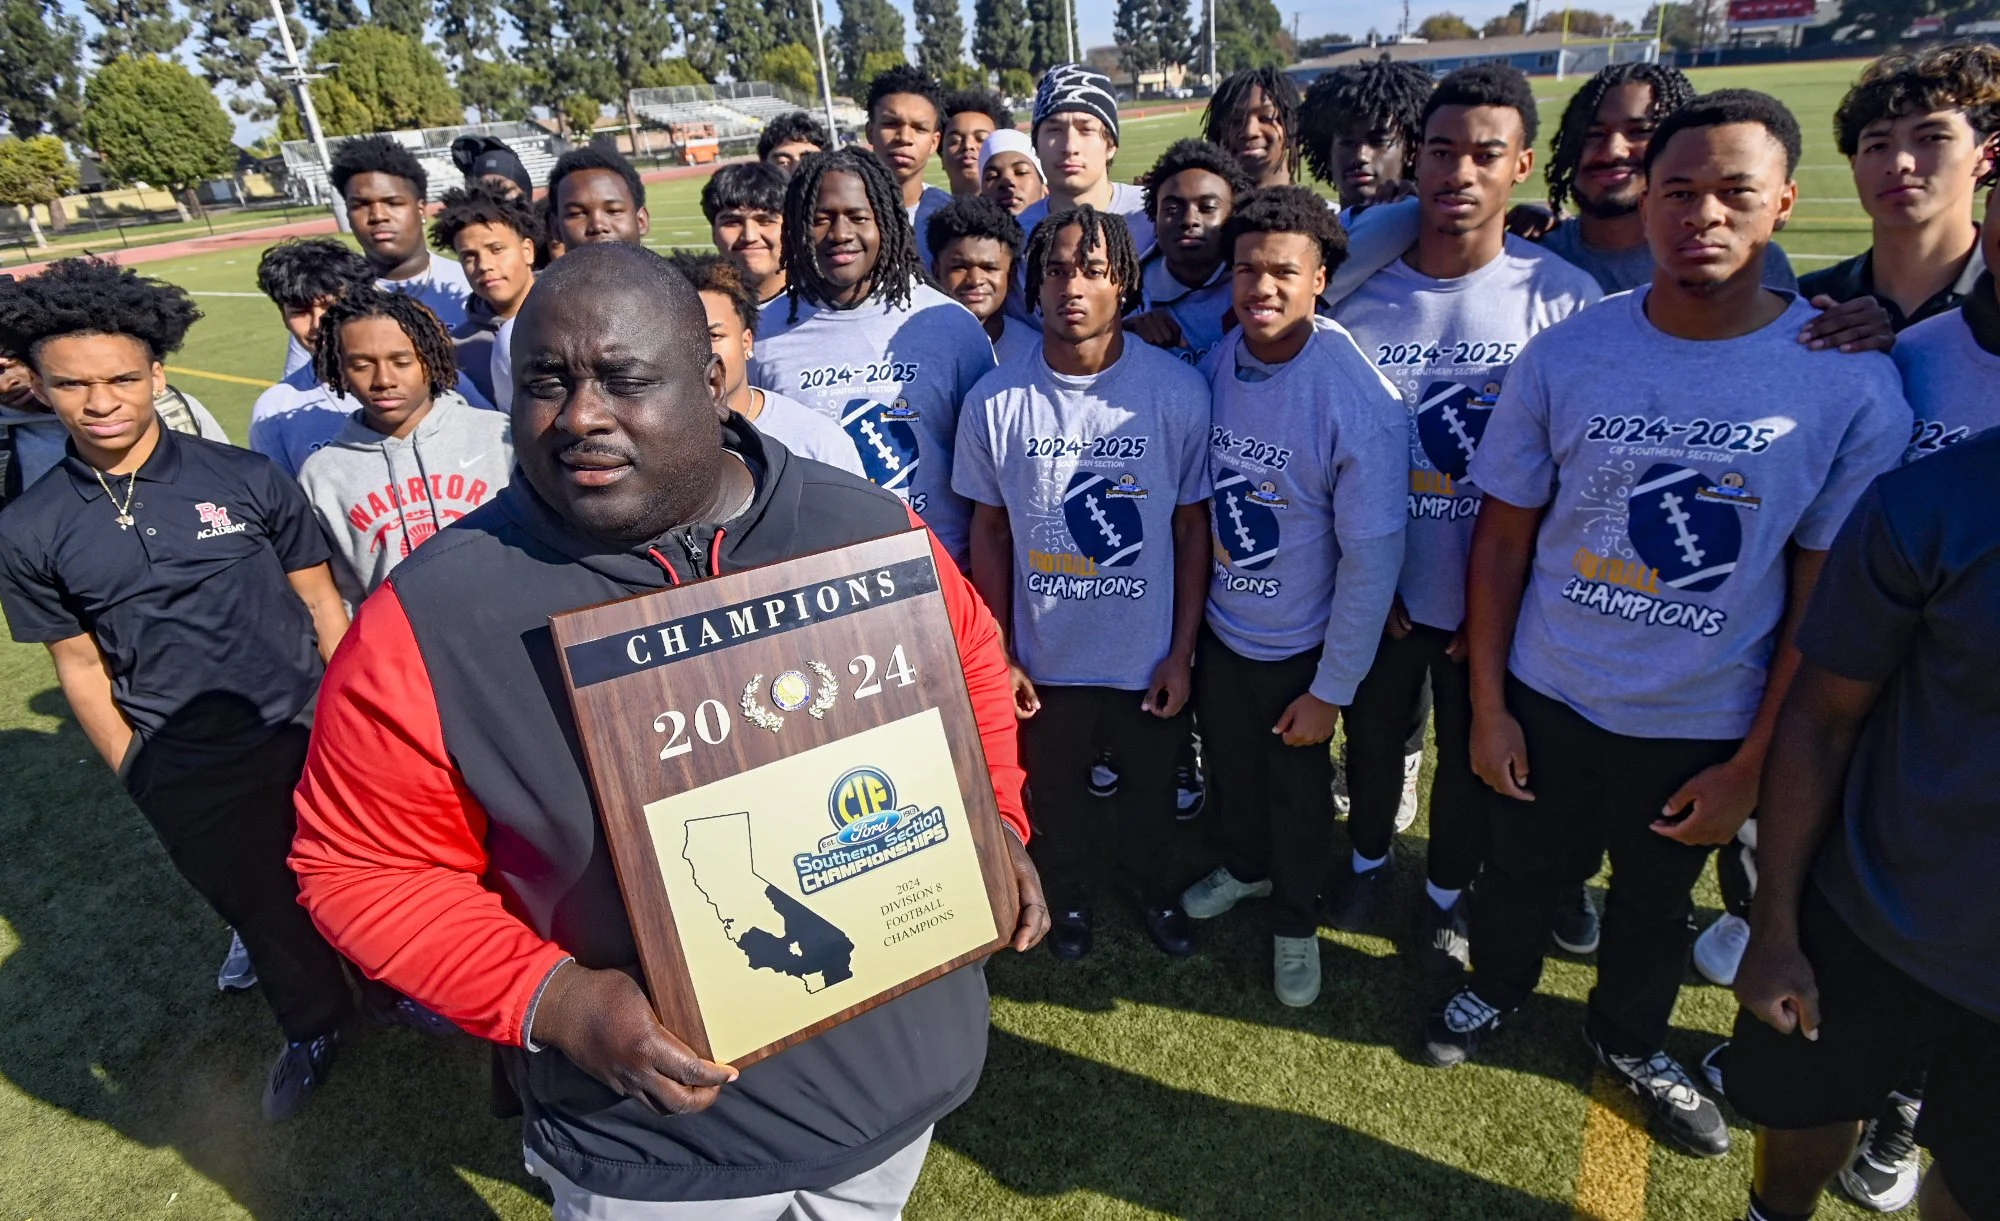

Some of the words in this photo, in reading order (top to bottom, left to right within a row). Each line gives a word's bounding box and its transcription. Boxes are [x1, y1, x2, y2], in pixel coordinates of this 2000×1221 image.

[1378, 340, 1517, 367] 2024-2025
[801, 362, 920, 391] 2024-2025
[1411, 367, 1453, 377] SOUTHERN
[868, 385, 899, 394] SECTION
[1026, 436, 1149, 460] 2024-2025
[1209, 423, 1292, 471] 024-2025
[1587, 414, 1774, 454] 2024-2025
[1057, 460, 1092, 468] SOUTHERN
[1094, 460, 1125, 468] SECTION
[1609, 446, 1626, 455] CIF
[1628, 446, 1684, 458] SOUTHERN
[1686, 448, 1735, 464] SECTION
[195, 502, 231, 528] PM
[1408, 494, 1481, 520] AMPIO
[197, 523, 246, 540] ACADEMY
[1029, 549, 1099, 577] FOOTBALL
[1028, 573, 1147, 600] CHAMPIONS
[1213, 558, 1280, 598] MPIONS
[627, 570, 896, 665] CHAMPIONS
[1561, 574, 1727, 636] CHAMPIONS
[653, 699, 731, 761] 20
[847, 644, 917, 700] 24
[838, 775, 888, 824] CIF
[796, 843, 878, 875] Southern
[884, 808, 942, 848] Section
[850, 816, 890, 842] Ford
[801, 823, 947, 893] CHAMPIONSHIPS
[880, 887, 934, 916] DIVISION
[936, 883, 943, 892] 8
[896, 878, 921, 895] 2024
[883, 909, 955, 947] CHAMPIONS
[885, 899, 945, 930] FOOTBALL
